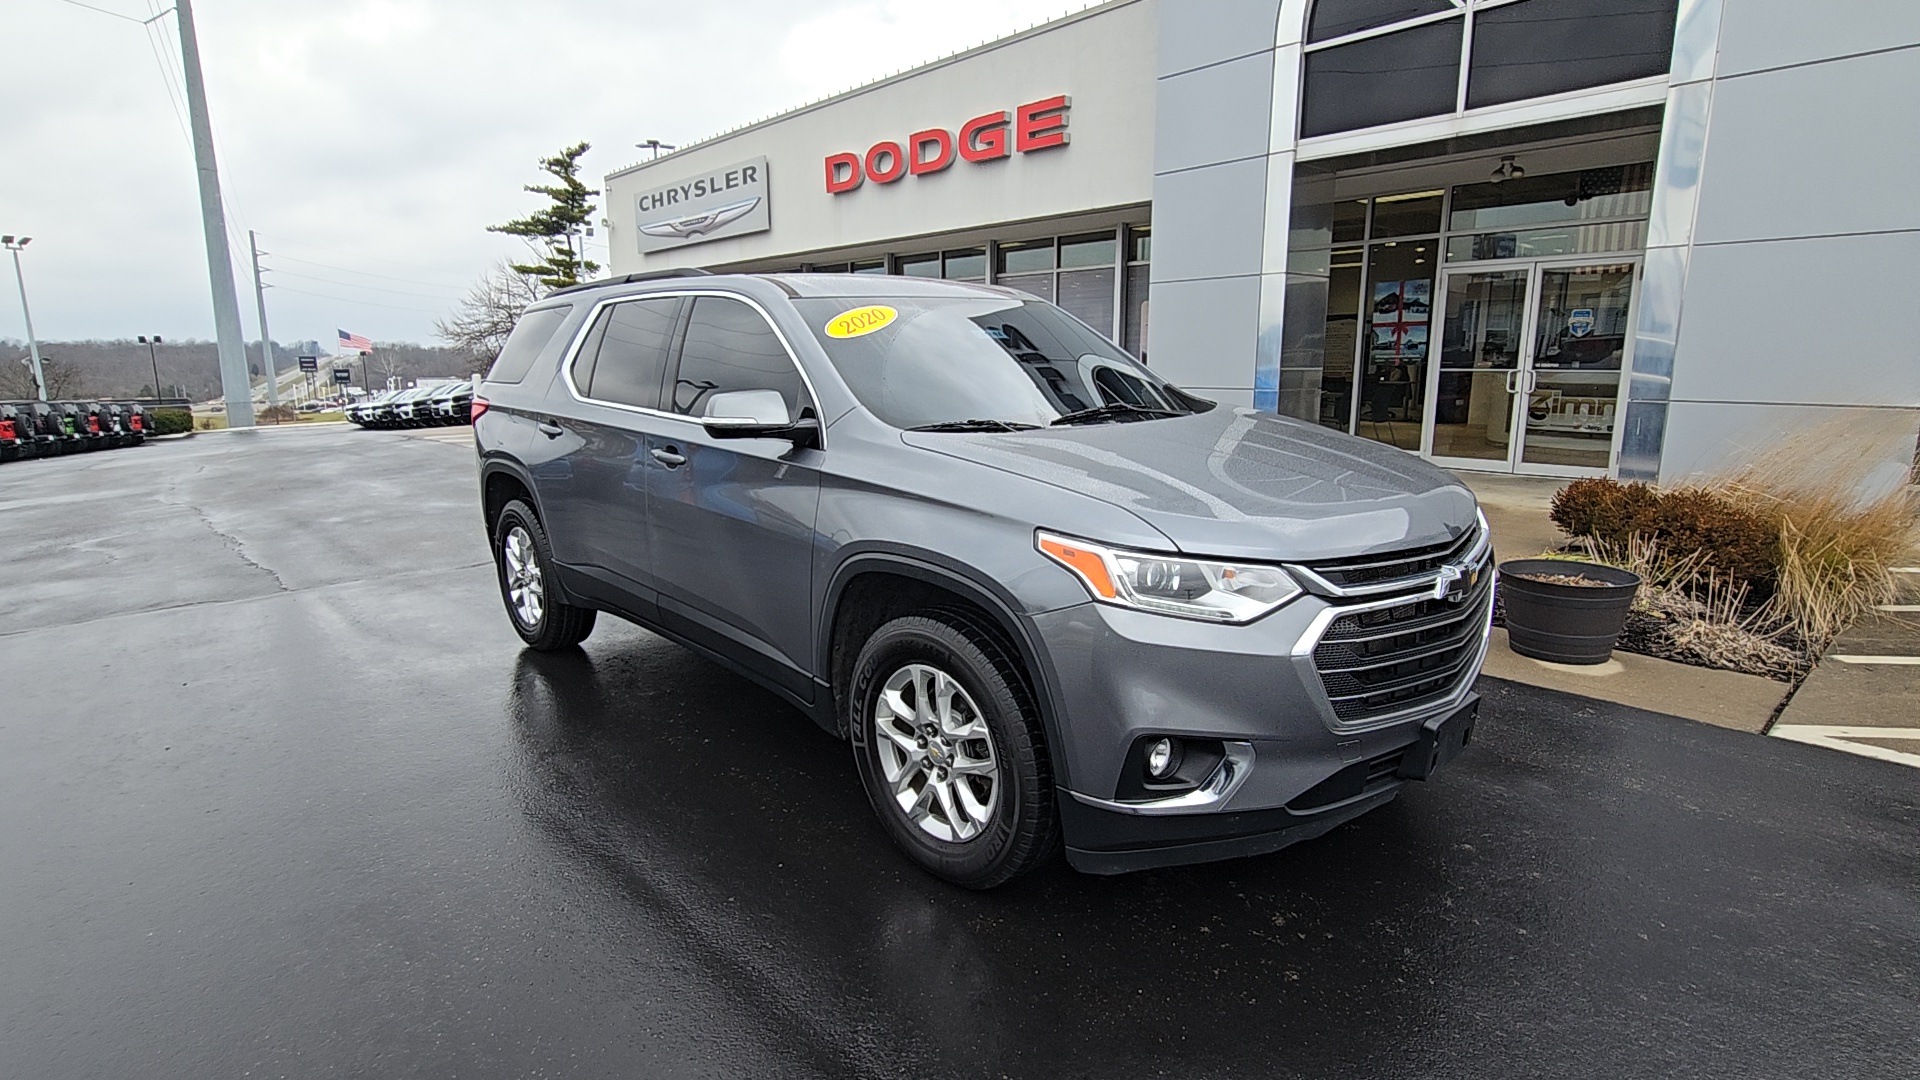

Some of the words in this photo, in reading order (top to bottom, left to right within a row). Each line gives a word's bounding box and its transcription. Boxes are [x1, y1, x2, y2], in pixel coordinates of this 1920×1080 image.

[825, 95, 1072, 193] DODGE
[639, 165, 758, 212] CHRYSLER
[839, 309, 886, 334] 2020
